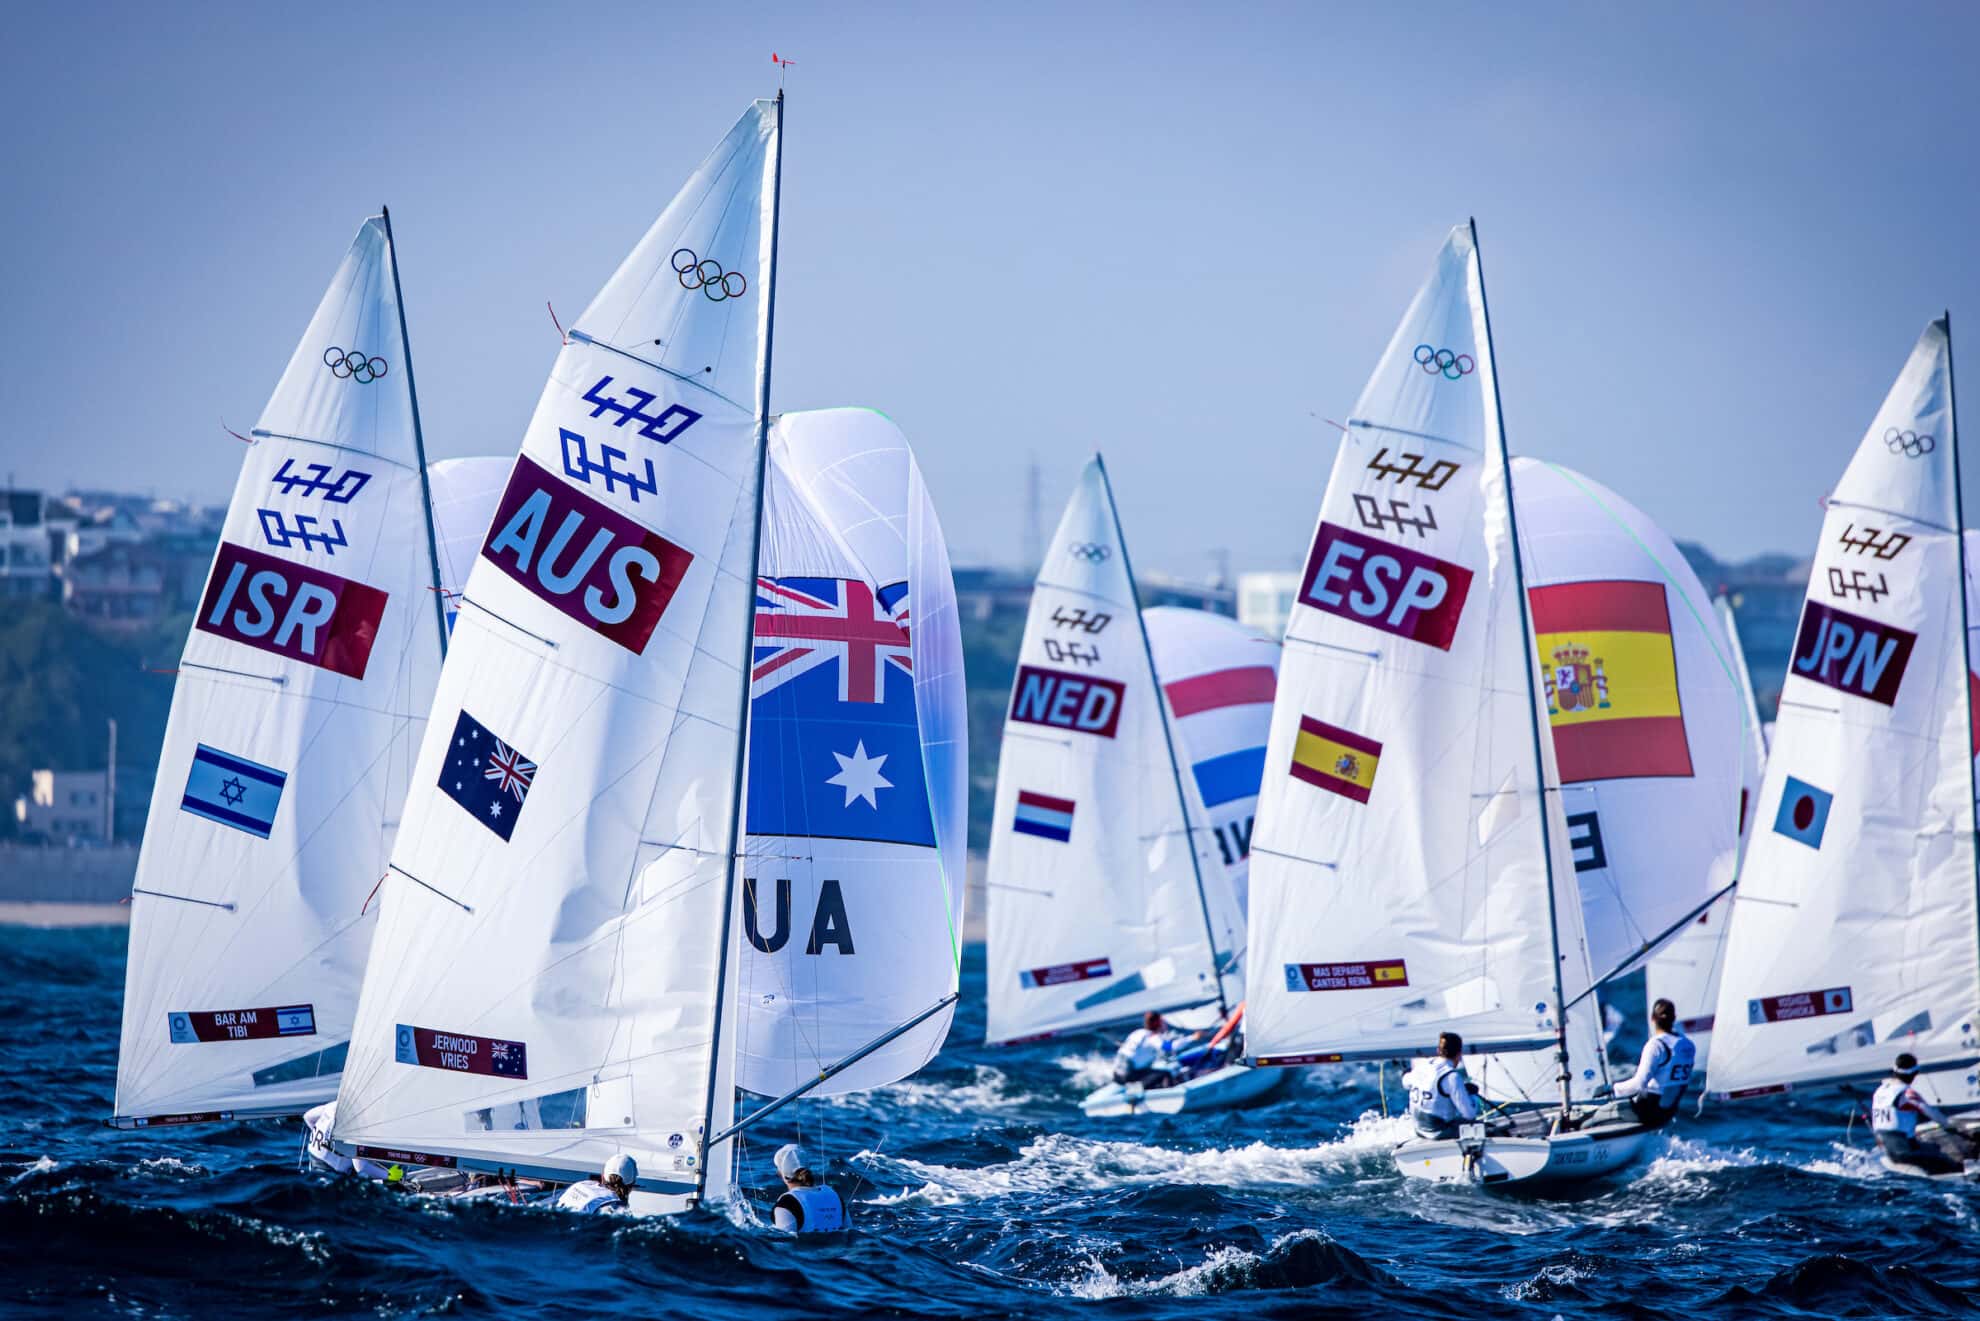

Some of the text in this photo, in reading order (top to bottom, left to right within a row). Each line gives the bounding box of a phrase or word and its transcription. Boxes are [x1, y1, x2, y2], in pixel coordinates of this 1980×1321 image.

[581, 375, 703, 444] 470
[272, 458, 373, 504] 470
[1367, 447, 1461, 491] 470
[489, 487, 661, 625] AUS
[1839, 523, 1912, 560] 470
[1308, 539, 1449, 628] ESP
[208, 561, 337, 656] ISR
[1796, 617, 1899, 694] JPN
[1016, 673, 1117, 731] NED
[214, 1011, 257, 1026] BAR AM
[227, 1025, 248, 1038] TIBI
[432, 1034, 478, 1055] JERWOOD
[440, 1051, 469, 1070] VRIES
[1670, 1063, 1694, 1081] ES
[1873, 1108, 1891, 1122] PN
